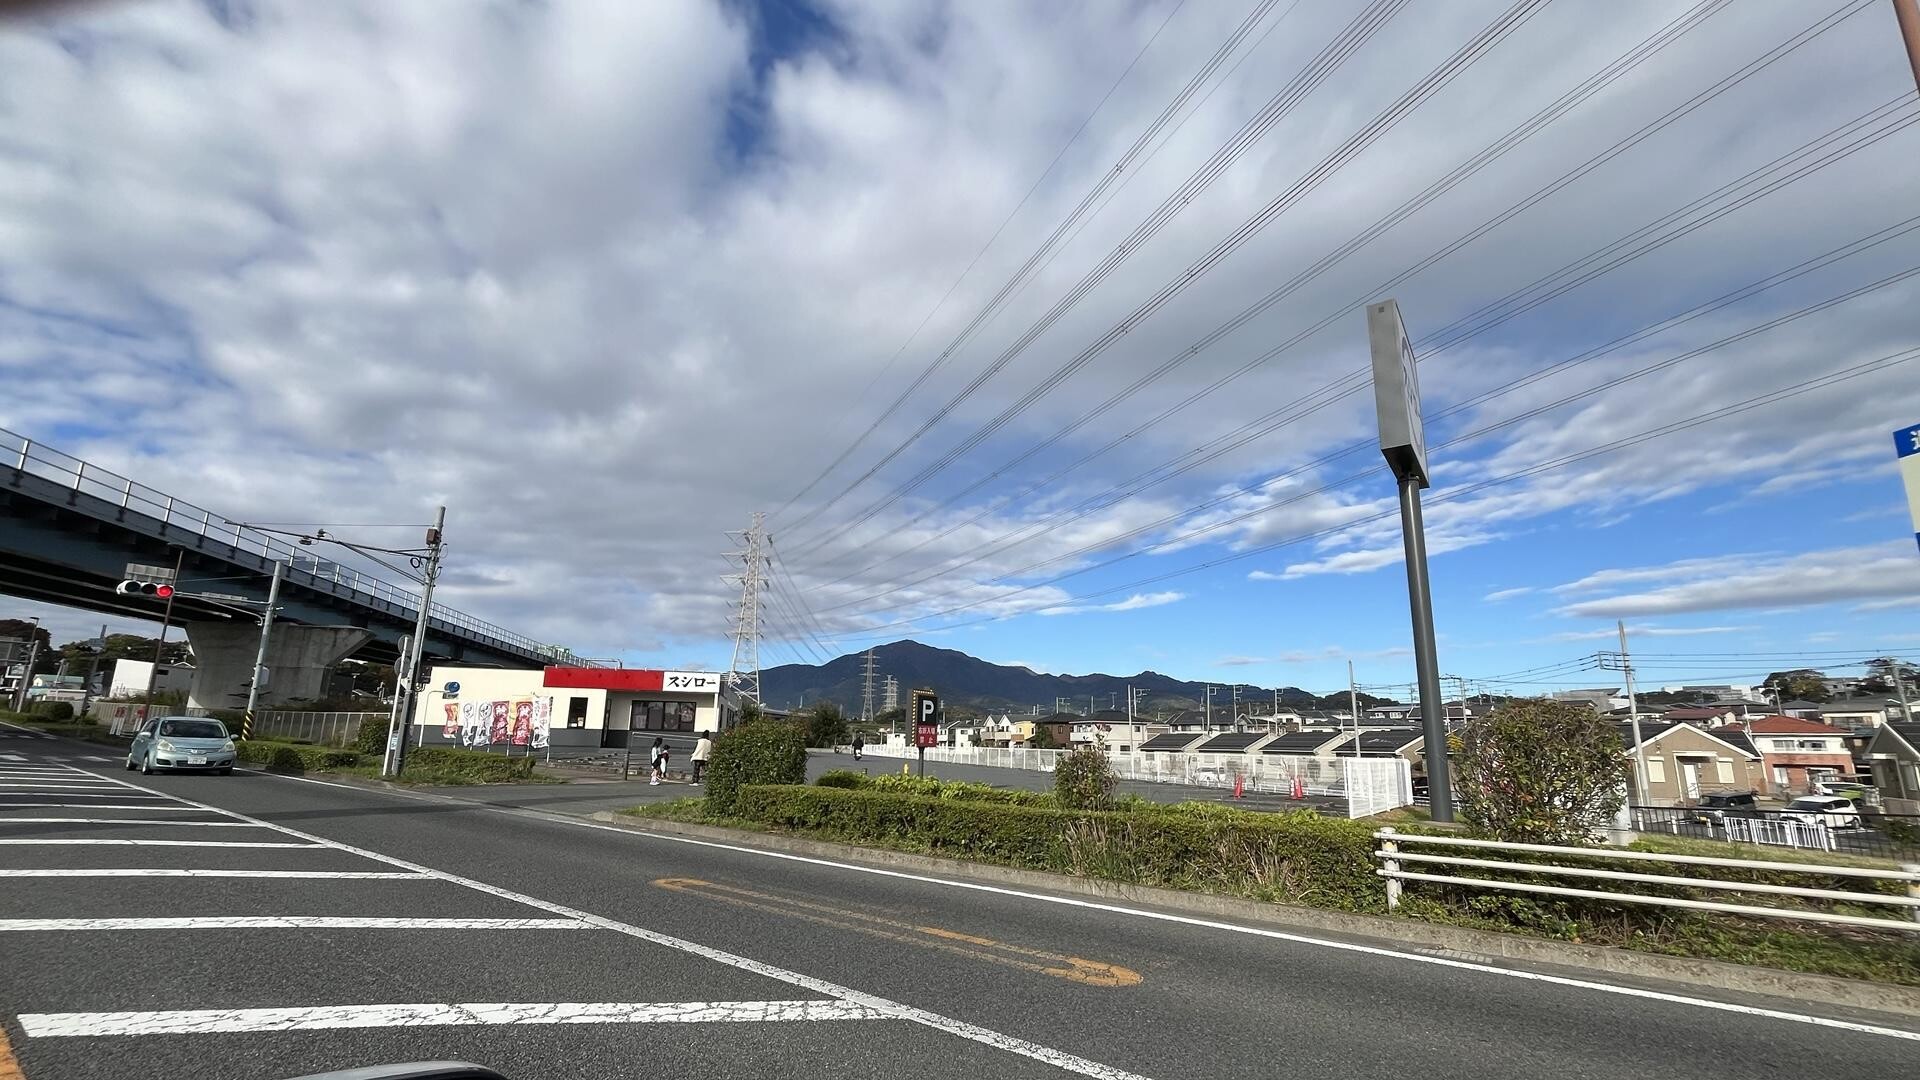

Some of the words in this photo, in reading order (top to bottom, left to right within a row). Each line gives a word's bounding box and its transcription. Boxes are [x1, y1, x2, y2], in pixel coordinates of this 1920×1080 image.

[667, 676, 717, 688] スシロー
[923, 700, 934, 721] P
